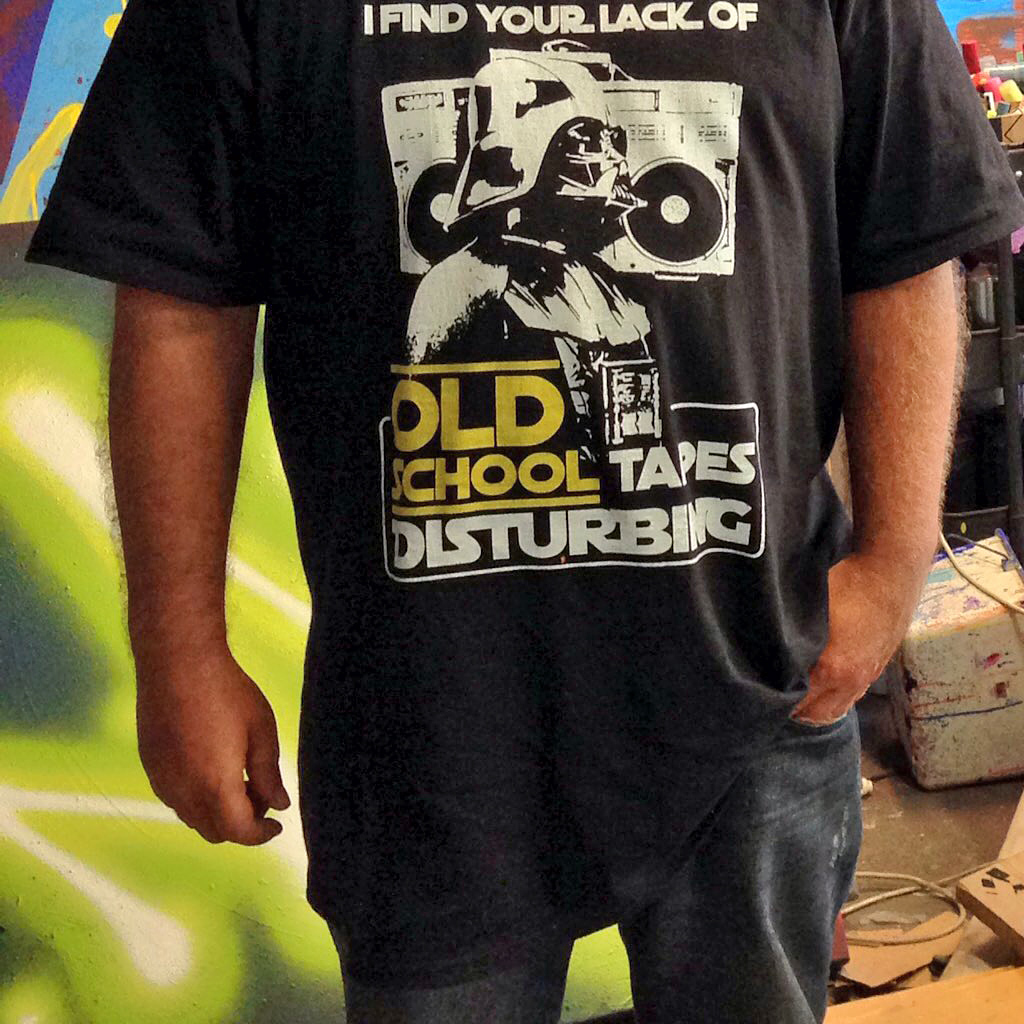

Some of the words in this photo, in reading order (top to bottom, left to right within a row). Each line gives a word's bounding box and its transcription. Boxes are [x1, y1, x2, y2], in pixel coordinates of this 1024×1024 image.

[363, 3, 375, 36] I
[380, 2, 469, 34] FIND
[476, 2, 597, 35] YOUR
[599, 1, 704, 34] LACK
[708, 1, 759, 32] OF
[391, 374, 566, 453] OLD
[607, 440, 757, 494] TAPES
[391, 495, 754, 571] DISTURBING
